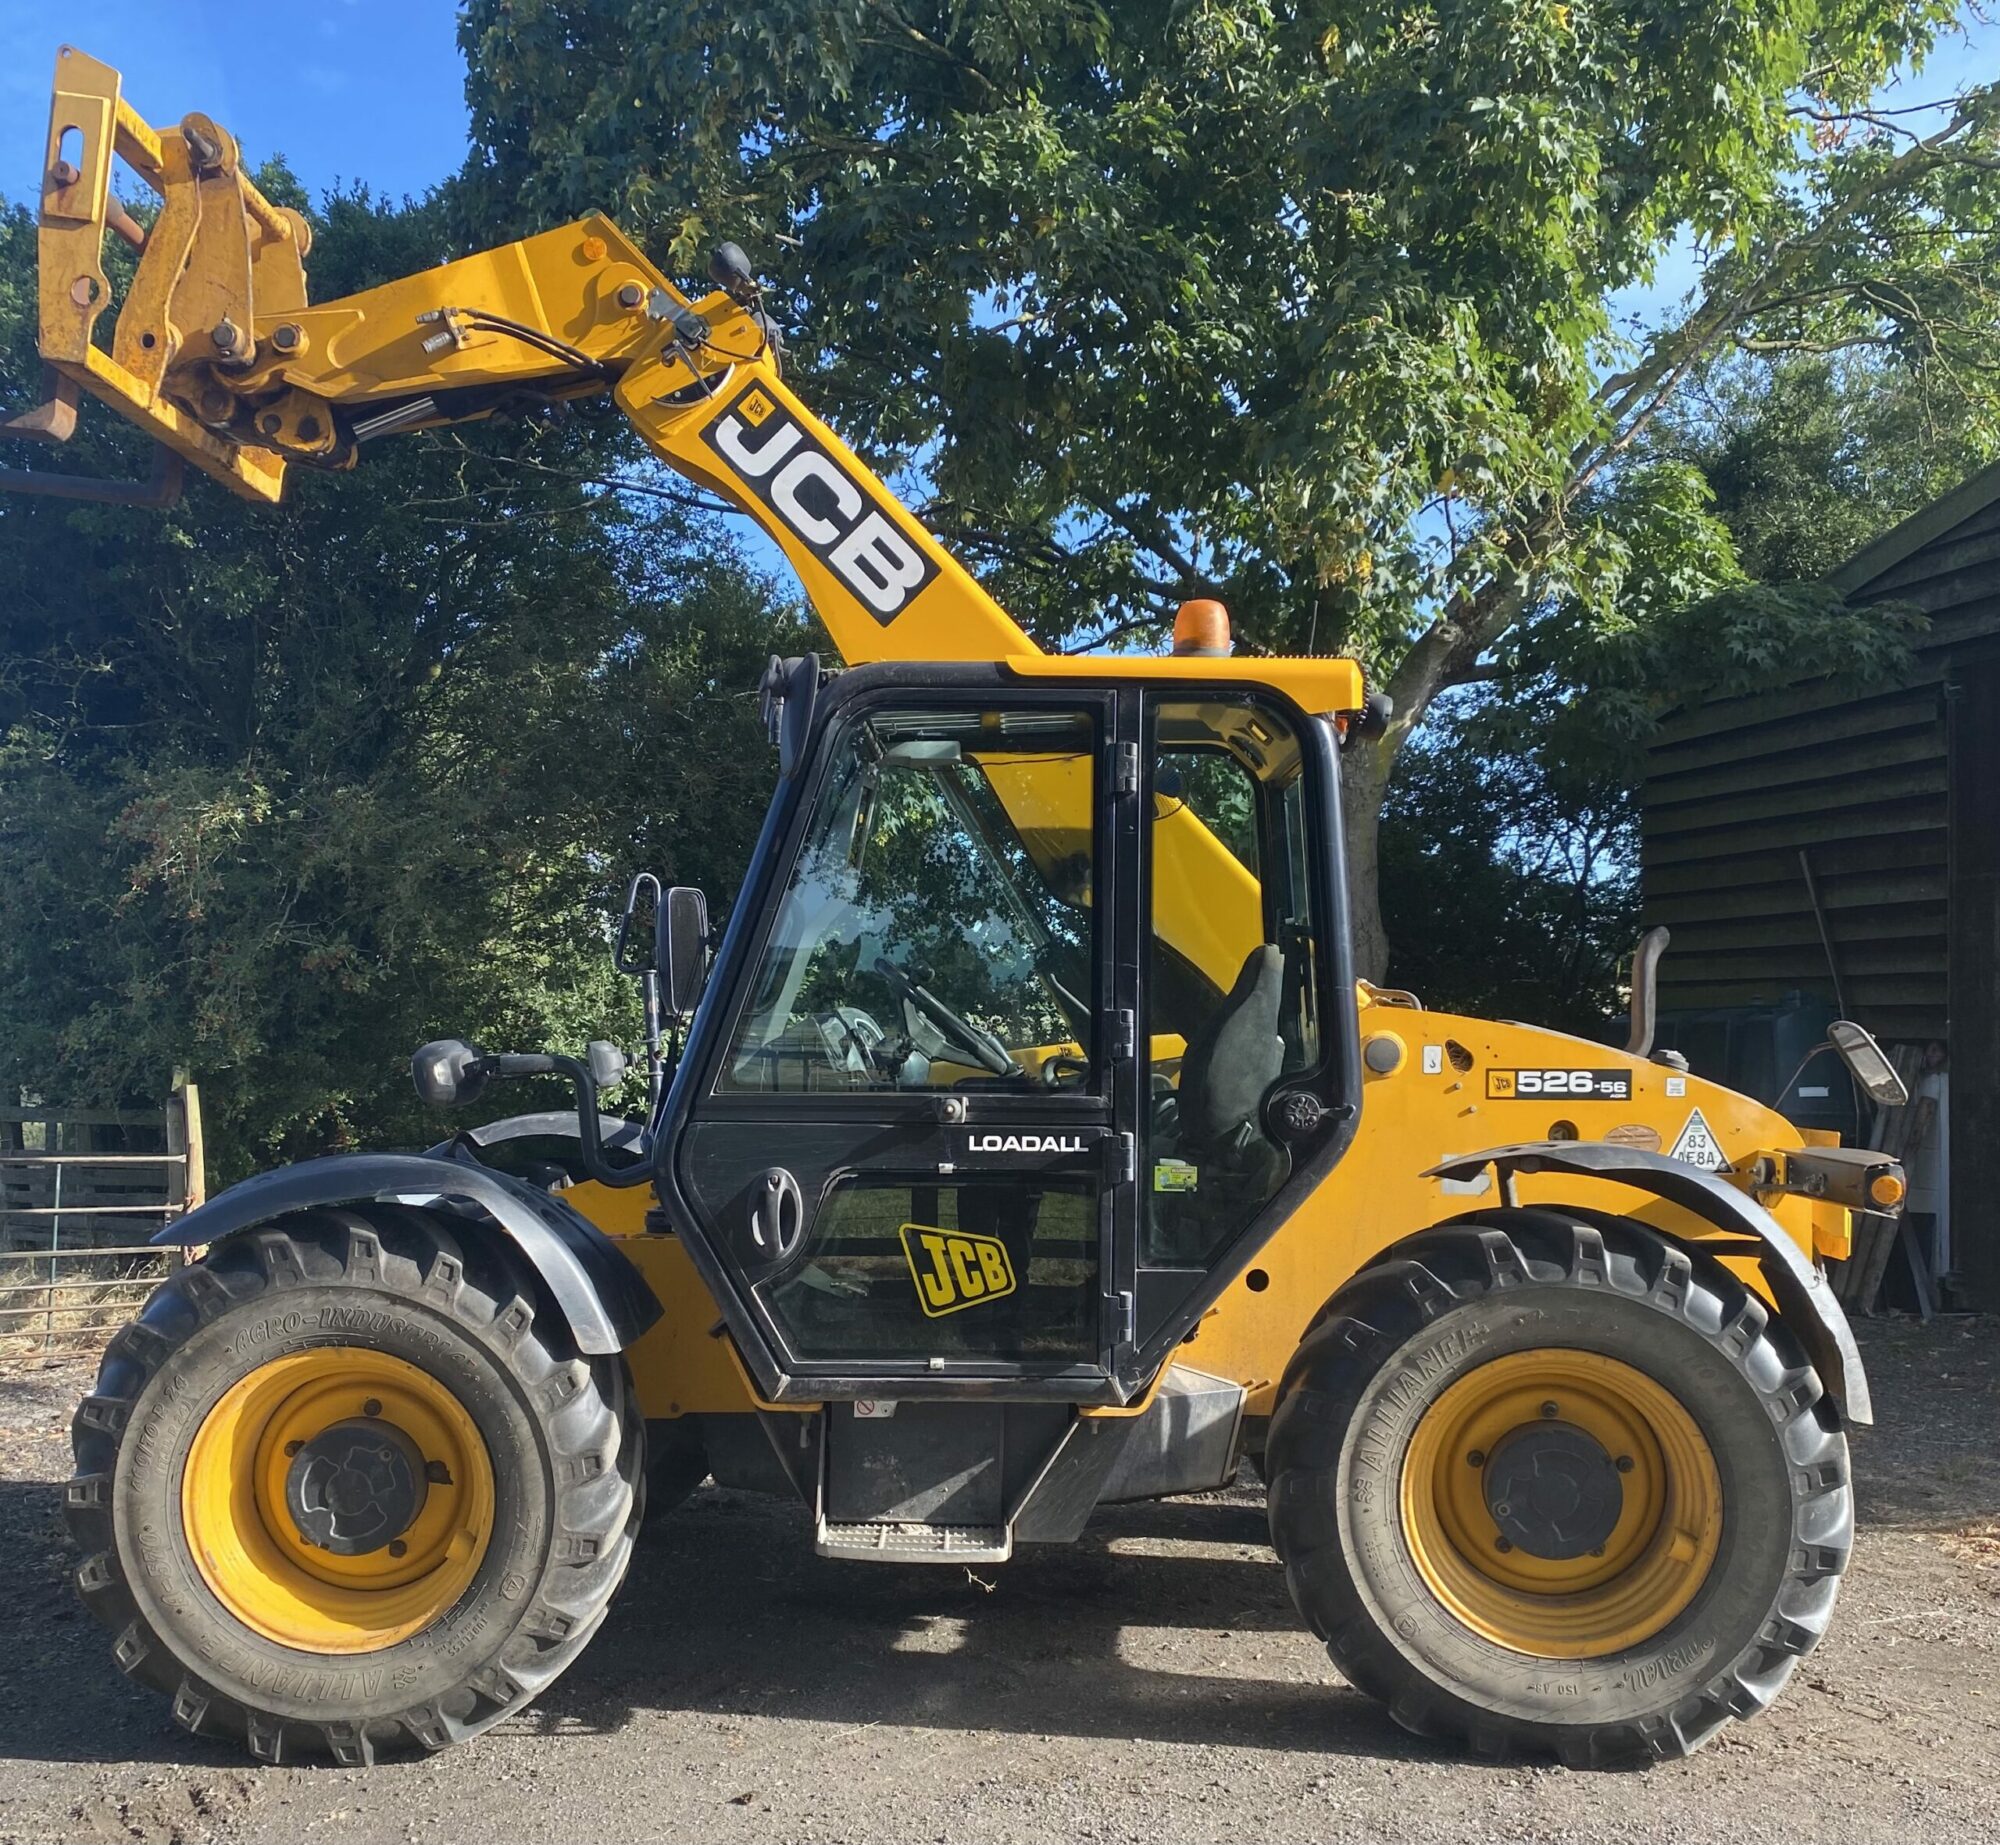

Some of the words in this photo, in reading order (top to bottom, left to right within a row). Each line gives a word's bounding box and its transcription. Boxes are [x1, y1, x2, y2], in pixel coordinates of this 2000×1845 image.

[715, 414, 925, 612] JCB
[1517, 1071, 1627, 1093] 526-56
[968, 1135, 1089, 1152] LOADALL
[1688, 1135, 1706, 1149] 83
[1678, 1151, 1716, 1166] AE8A
[920, 1234, 1008, 1307] JCB
[164, 1374, 189, 1405] 24
[449, 1617, 489, 1657] TUBELESS
[200, 1632, 384, 1700] ALLIANCE
[1557, 1686, 1578, 1696] 150
